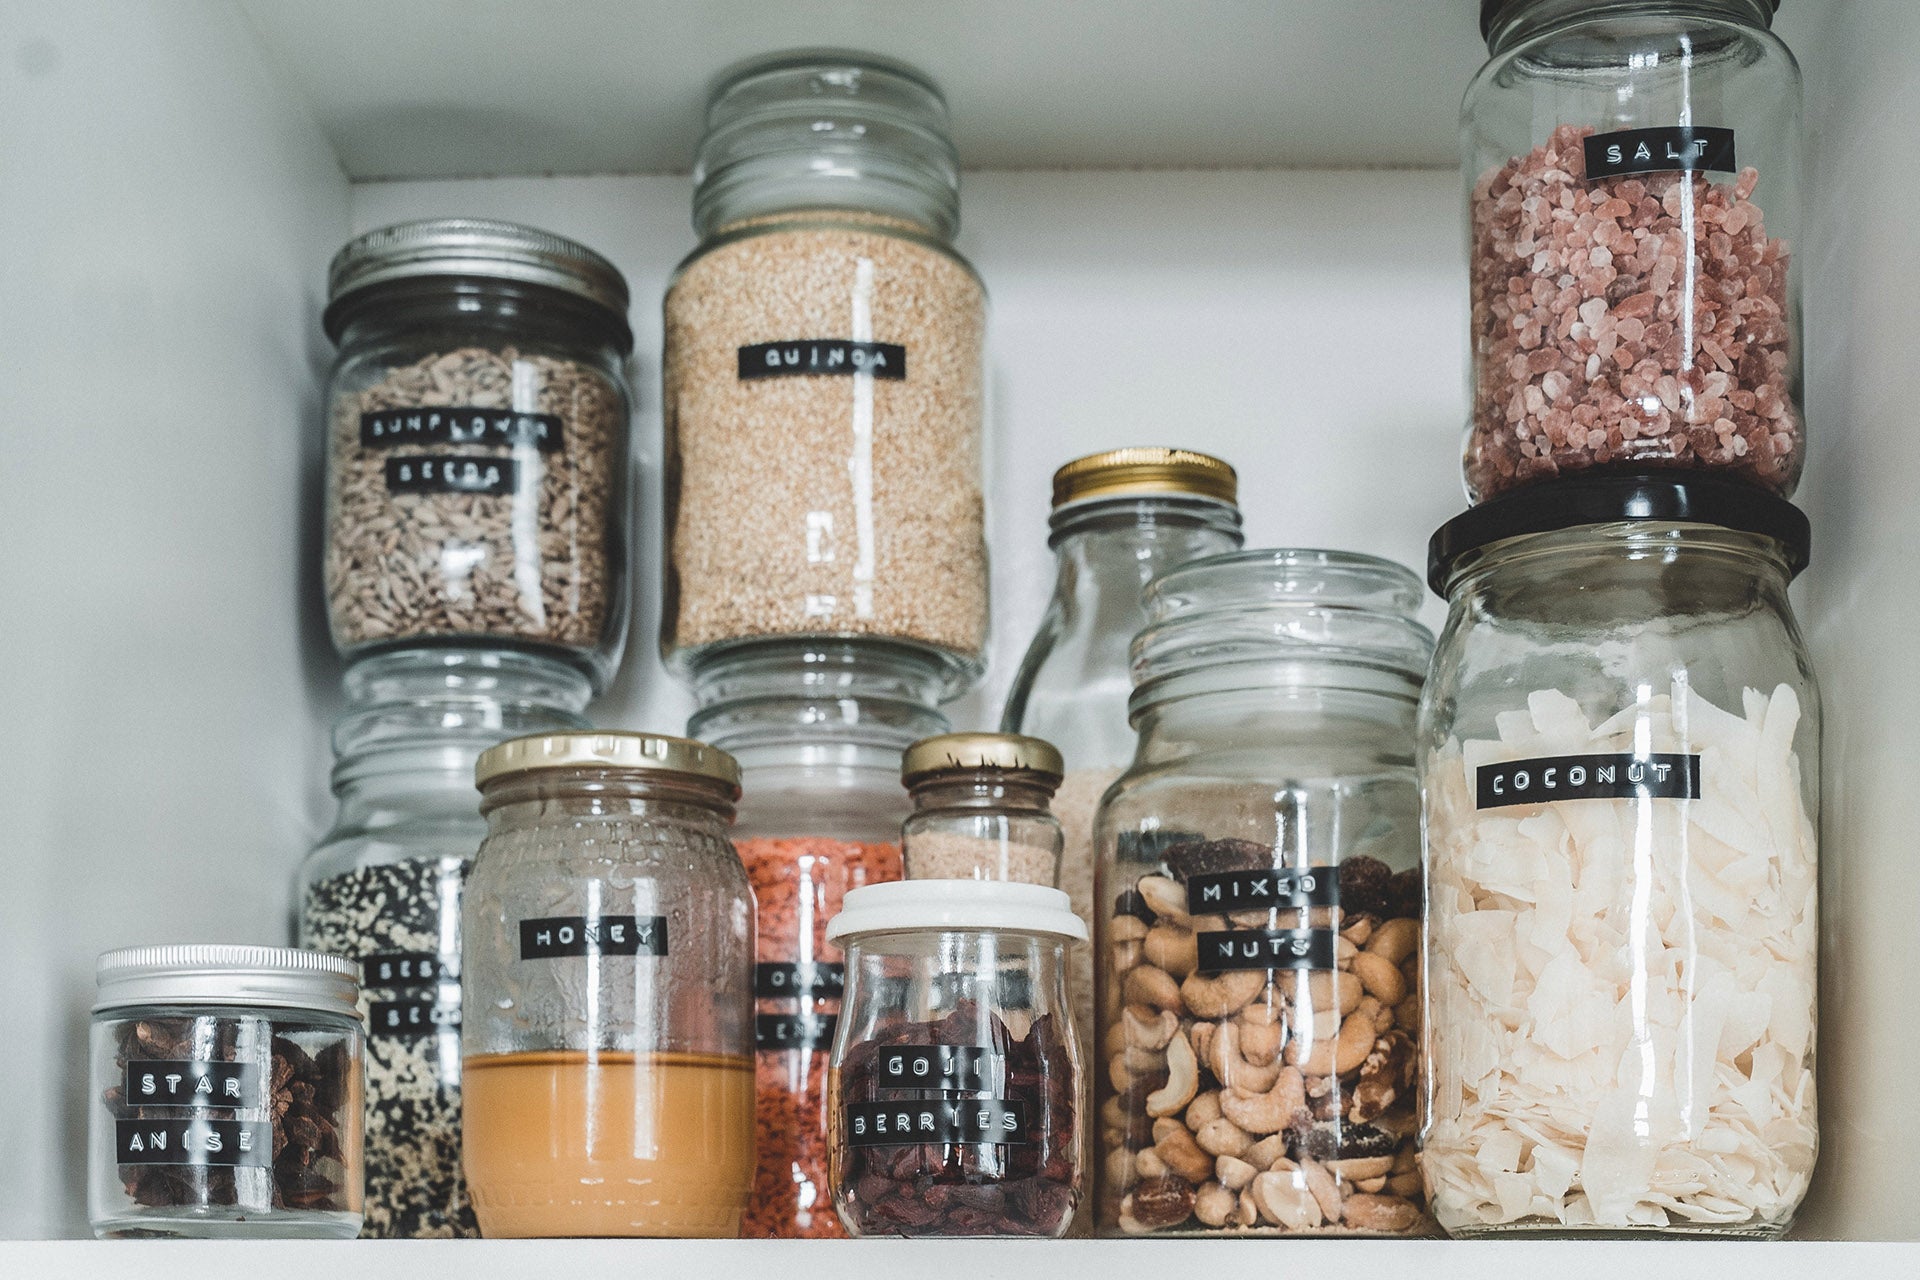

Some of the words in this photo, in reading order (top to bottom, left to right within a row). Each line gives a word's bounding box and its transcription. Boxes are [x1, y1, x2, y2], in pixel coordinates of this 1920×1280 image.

[1606, 138, 1709, 164] SALT
[765, 346, 887, 368] QUINOA
[1493, 763, 1673, 796] COCONUT
[1203, 874, 1317, 902] MIXED
[536, 923, 653, 947] HONEY
[1218, 937, 1311, 959] NUTS
[888, 1055, 982, 1077] GOJI
[140, 1072, 241, 1099] STAR
[854, 1110, 1018, 1135] BERRIES
[129, 1129, 253, 1153] ANISE
